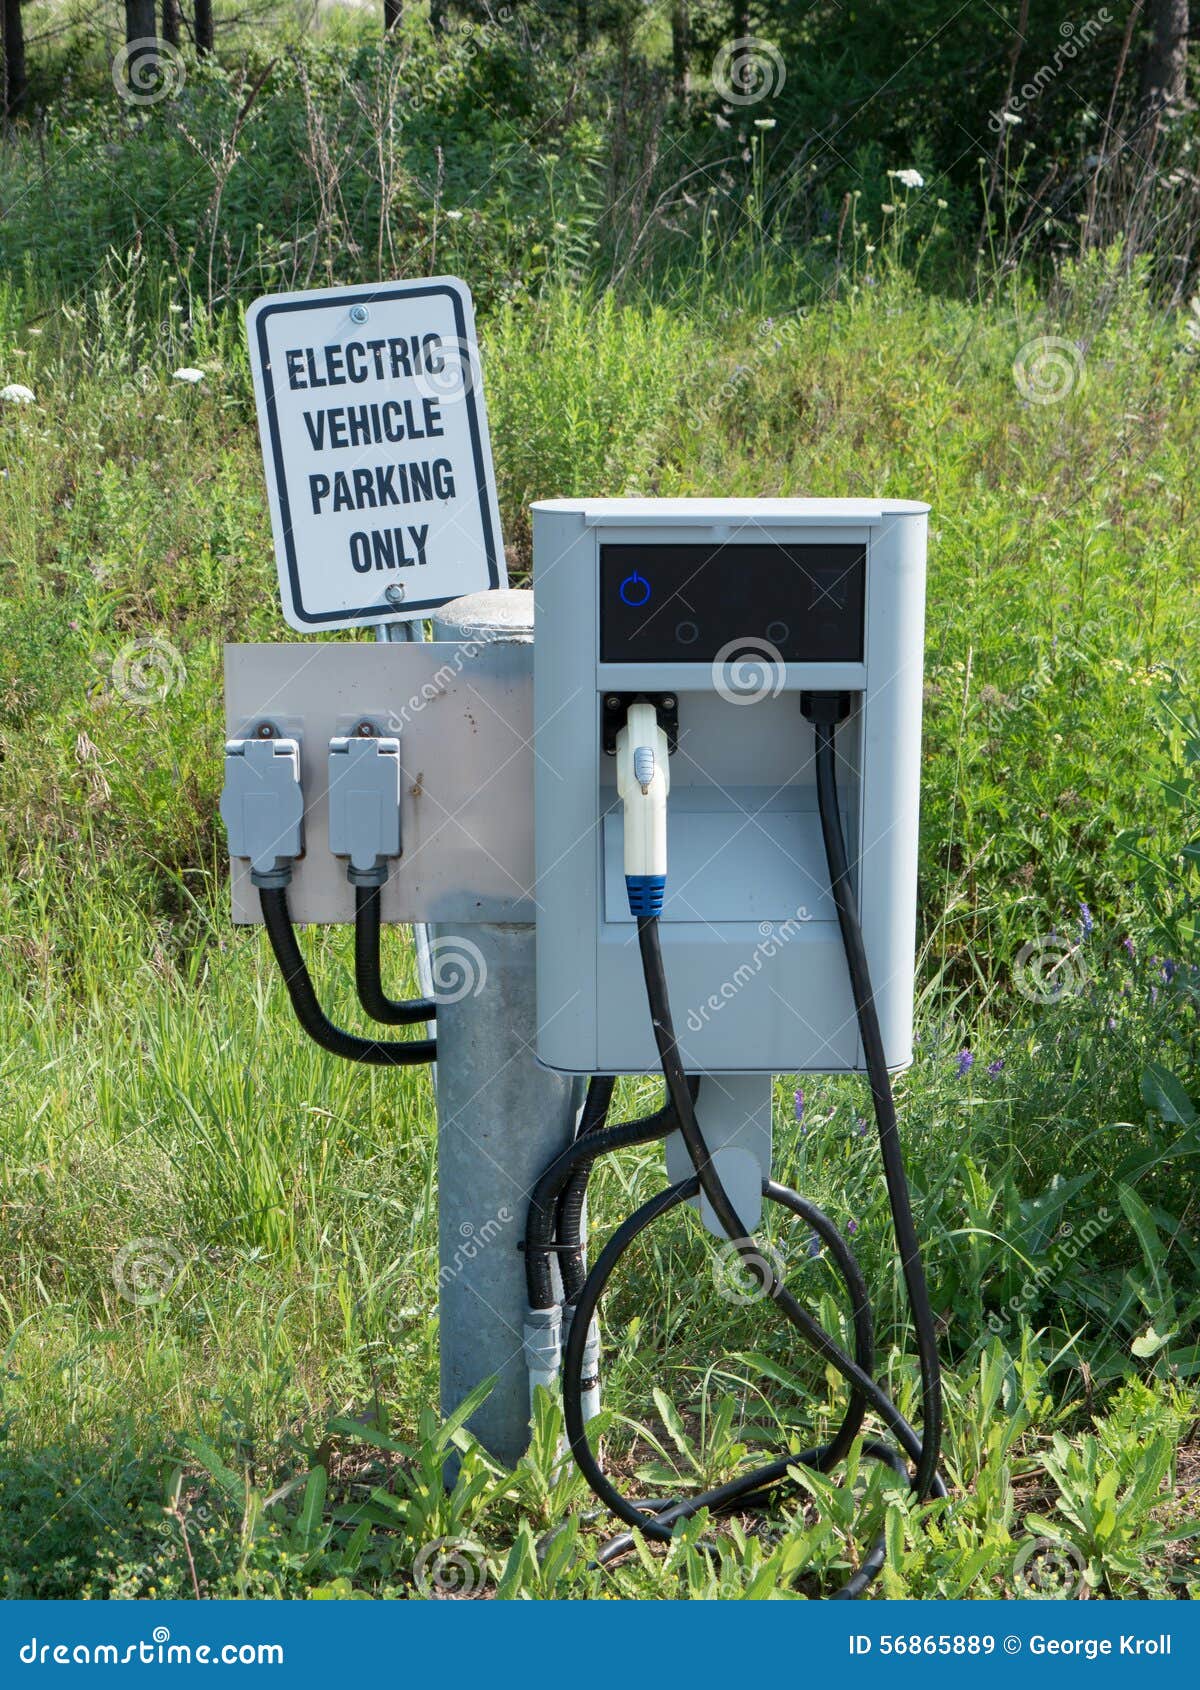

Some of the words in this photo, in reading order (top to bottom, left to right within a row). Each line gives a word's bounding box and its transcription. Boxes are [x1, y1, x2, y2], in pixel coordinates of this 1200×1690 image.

[286, 333, 446, 390] ELECTRIC
[303, 397, 444, 451] VEHICLE
[309, 458, 456, 515] PARKING
[350, 524, 429, 573] ONLY
